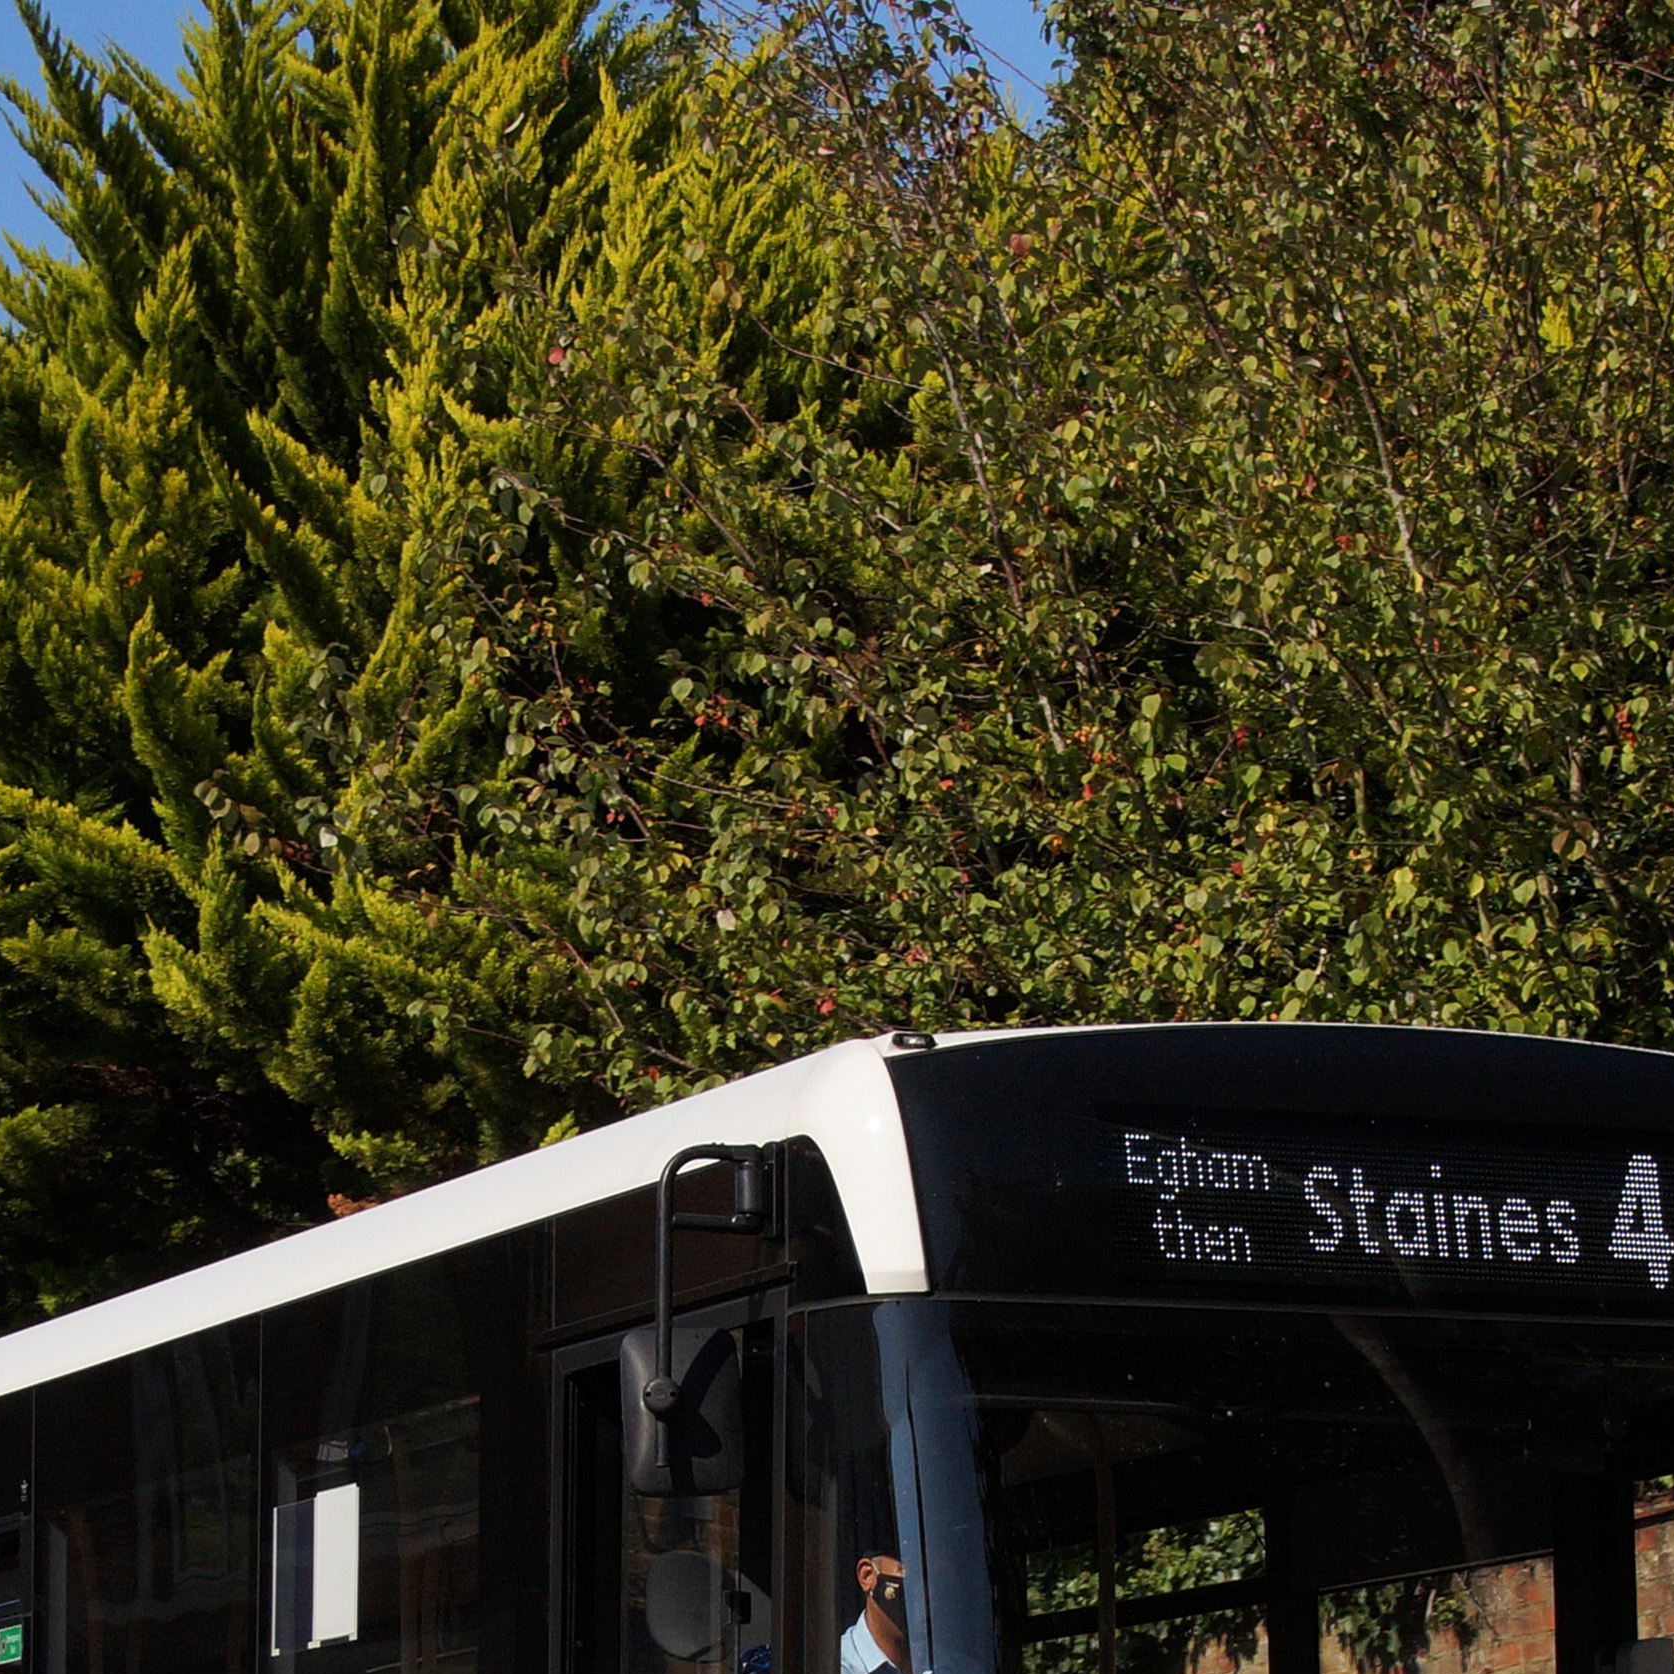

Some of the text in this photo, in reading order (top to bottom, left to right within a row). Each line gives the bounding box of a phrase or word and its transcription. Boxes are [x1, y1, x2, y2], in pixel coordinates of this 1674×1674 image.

[1124, 1133, 1270, 1200] Egham
[1153, 1208, 1252, 1262] then
[1303, 1165, 1580, 1264] Staines
